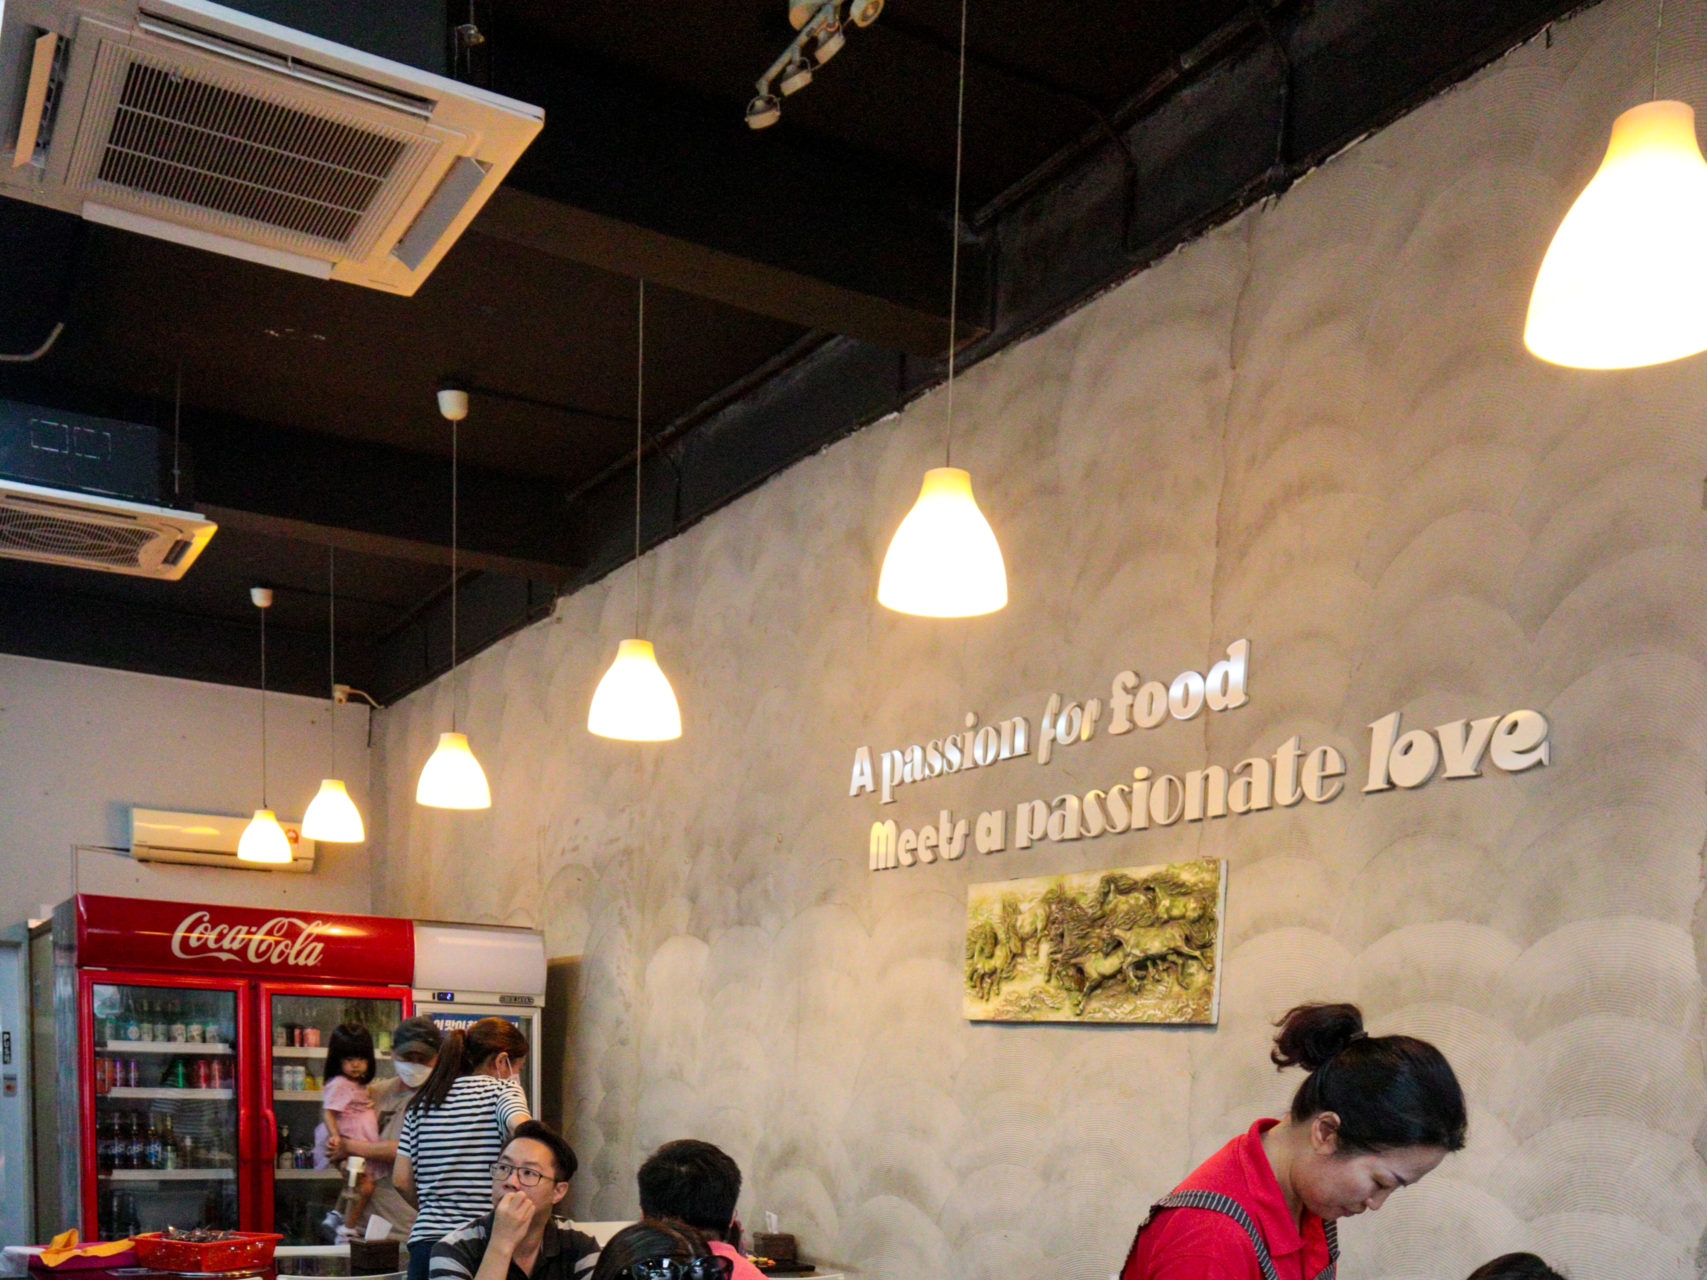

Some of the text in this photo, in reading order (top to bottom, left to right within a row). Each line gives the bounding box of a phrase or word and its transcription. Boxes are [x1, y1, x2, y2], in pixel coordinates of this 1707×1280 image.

[850, 638, 1250, 804] A passion for food
[869, 709, 1550, 871] Meets a passionate love
[171, 911, 325, 967] Coca-Cola
